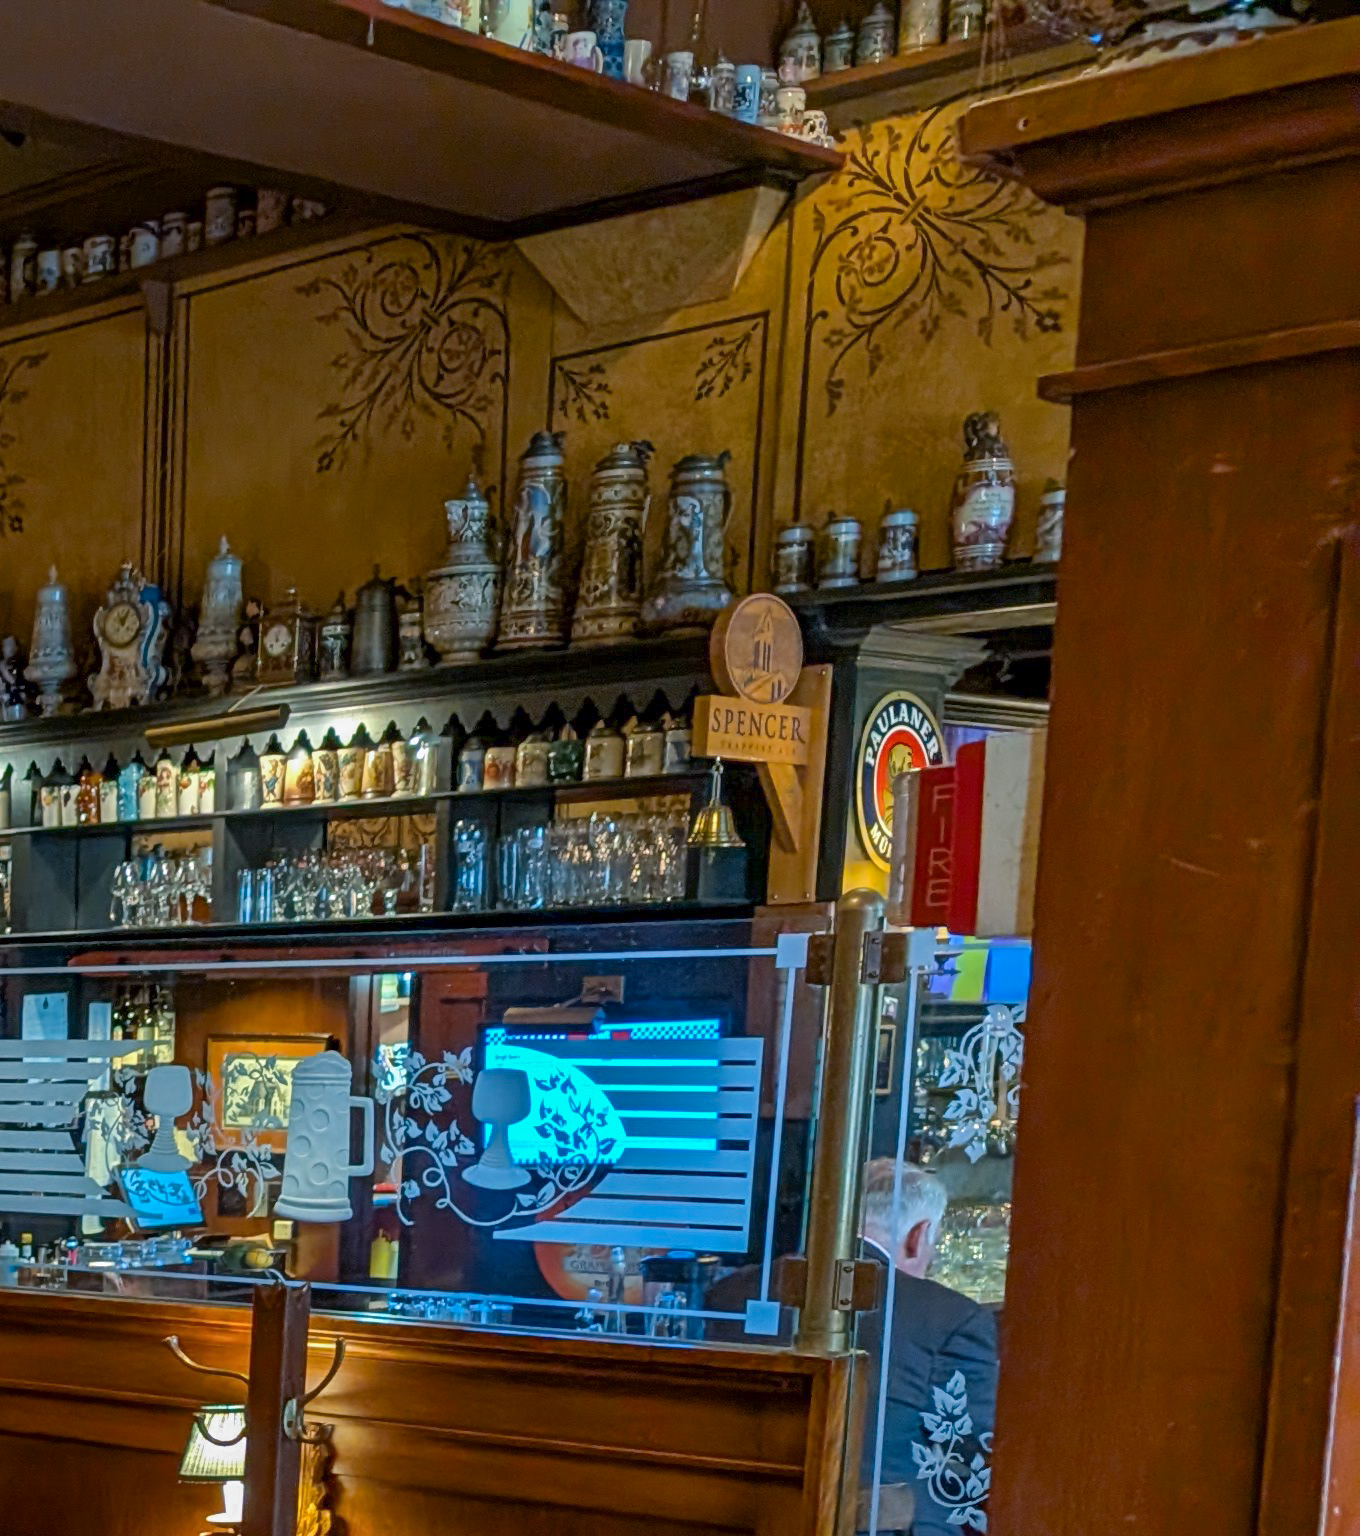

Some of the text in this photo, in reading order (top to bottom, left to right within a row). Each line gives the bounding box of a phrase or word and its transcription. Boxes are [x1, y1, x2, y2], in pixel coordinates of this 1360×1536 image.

[712, 707, 806, 744] SPENCER
[864, 702, 940, 767] PAULANER
[925, 783, 958, 907] FIRE
